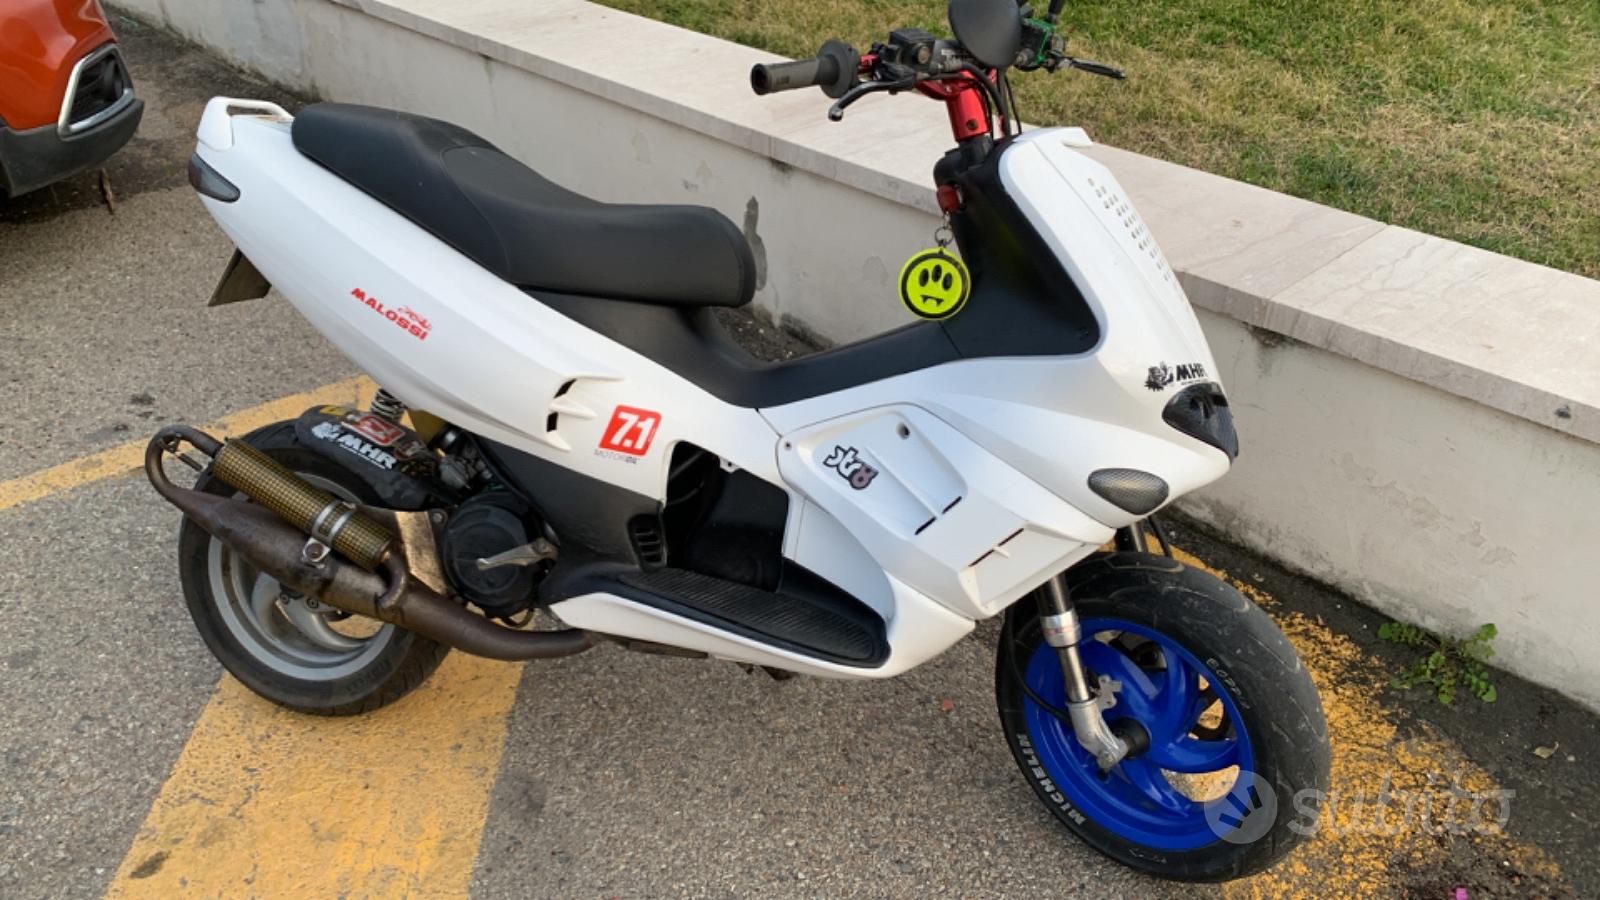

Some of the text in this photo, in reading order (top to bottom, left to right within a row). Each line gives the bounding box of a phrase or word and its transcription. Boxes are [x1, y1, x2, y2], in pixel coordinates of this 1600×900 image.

[351, 288, 428, 341] MALOSSI
[338, 434, 397, 469] MHR
[610, 411, 656, 450] 7.1
[1017, 734, 1086, 825] MICHELIN
